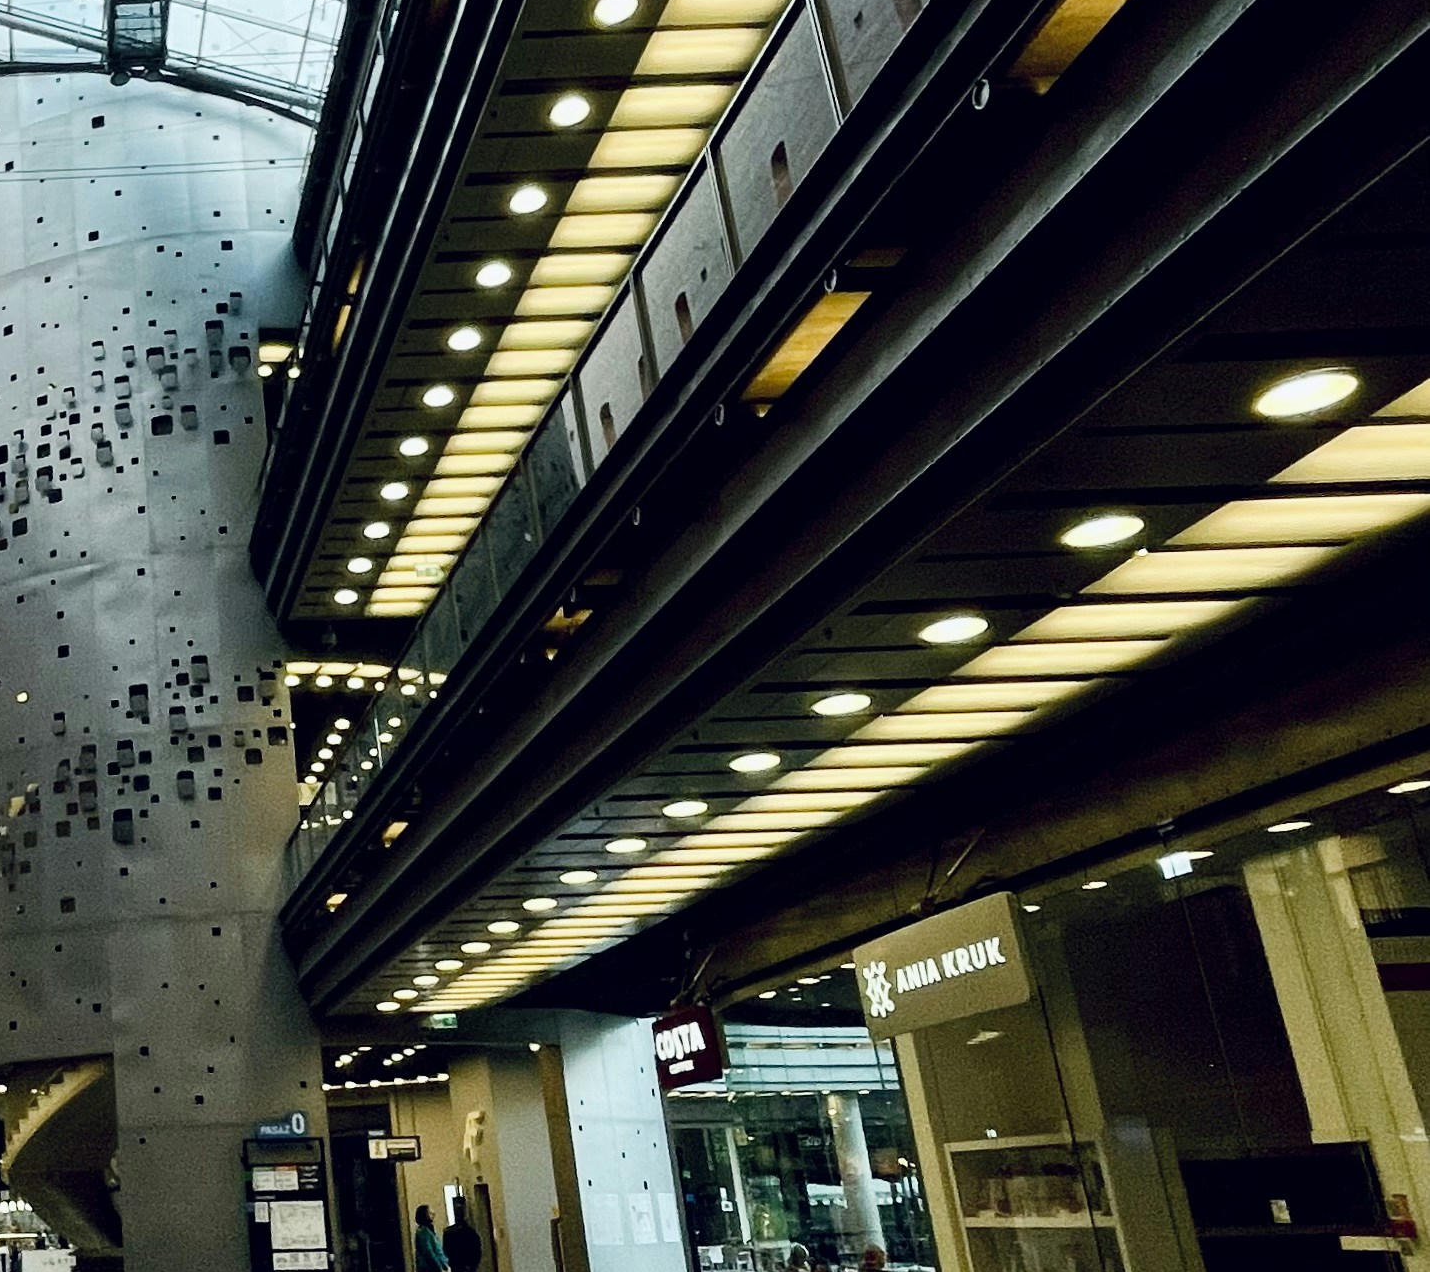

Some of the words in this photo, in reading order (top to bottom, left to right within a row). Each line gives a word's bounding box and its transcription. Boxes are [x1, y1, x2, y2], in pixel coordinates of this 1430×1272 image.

[896, 957, 942, 994] ANIA
[941, 936, 1006, 978] KRUK
[655, 1021, 706, 1061] COSTA
[291, 1113, 305, 1134] 0
